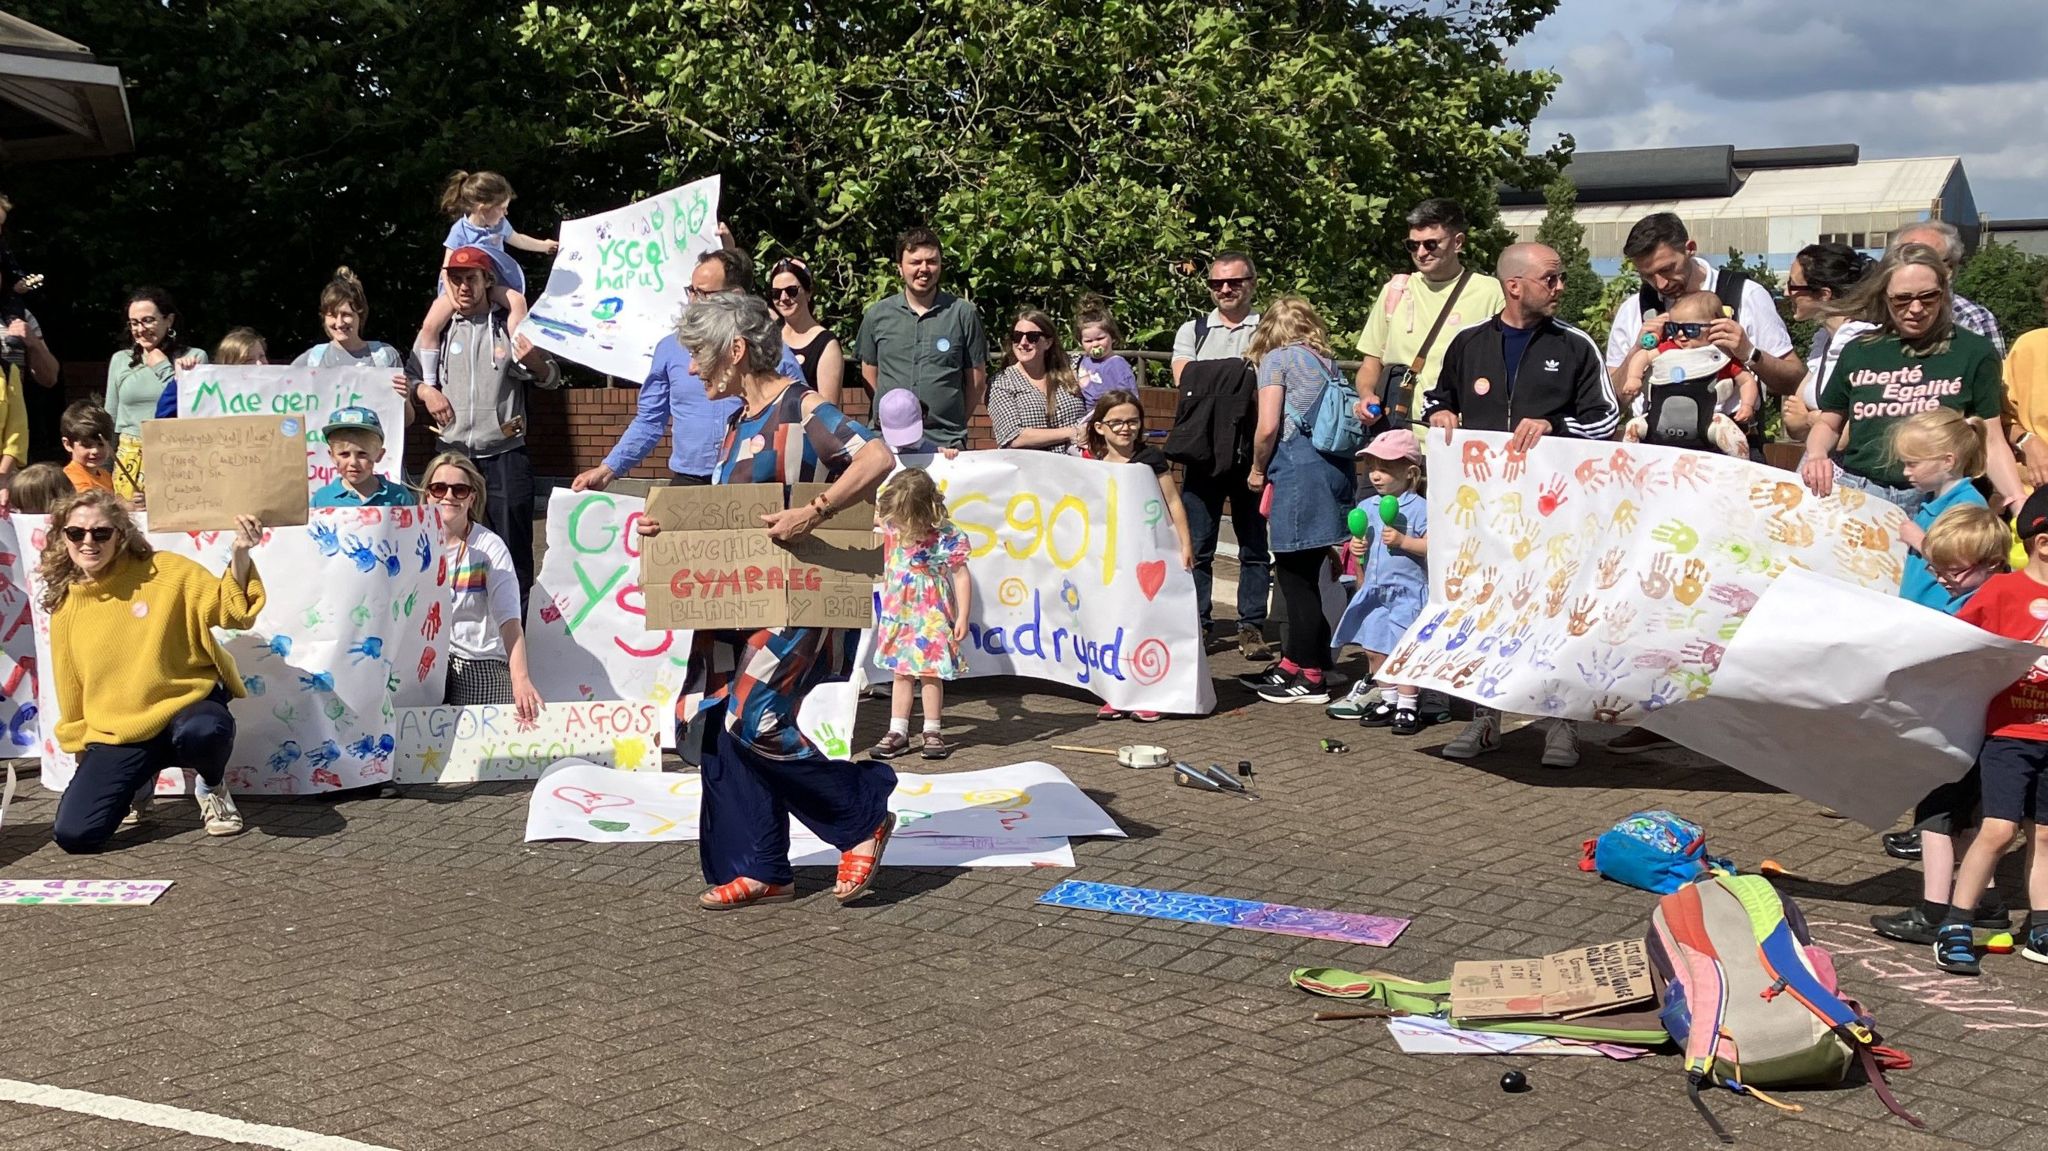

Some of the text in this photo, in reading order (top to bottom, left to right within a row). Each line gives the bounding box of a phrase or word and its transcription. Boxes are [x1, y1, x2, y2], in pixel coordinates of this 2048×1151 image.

[191, 379, 262, 414] Mae
[1853, 396, 1940, 420] Sororité
[880, 475, 1118, 586] sgol
[670, 564, 823, 599] GYMRAEG
[670, 595, 873, 623] BLANT Y BAE
[400, 703, 656, 741] AGOR AGOS
